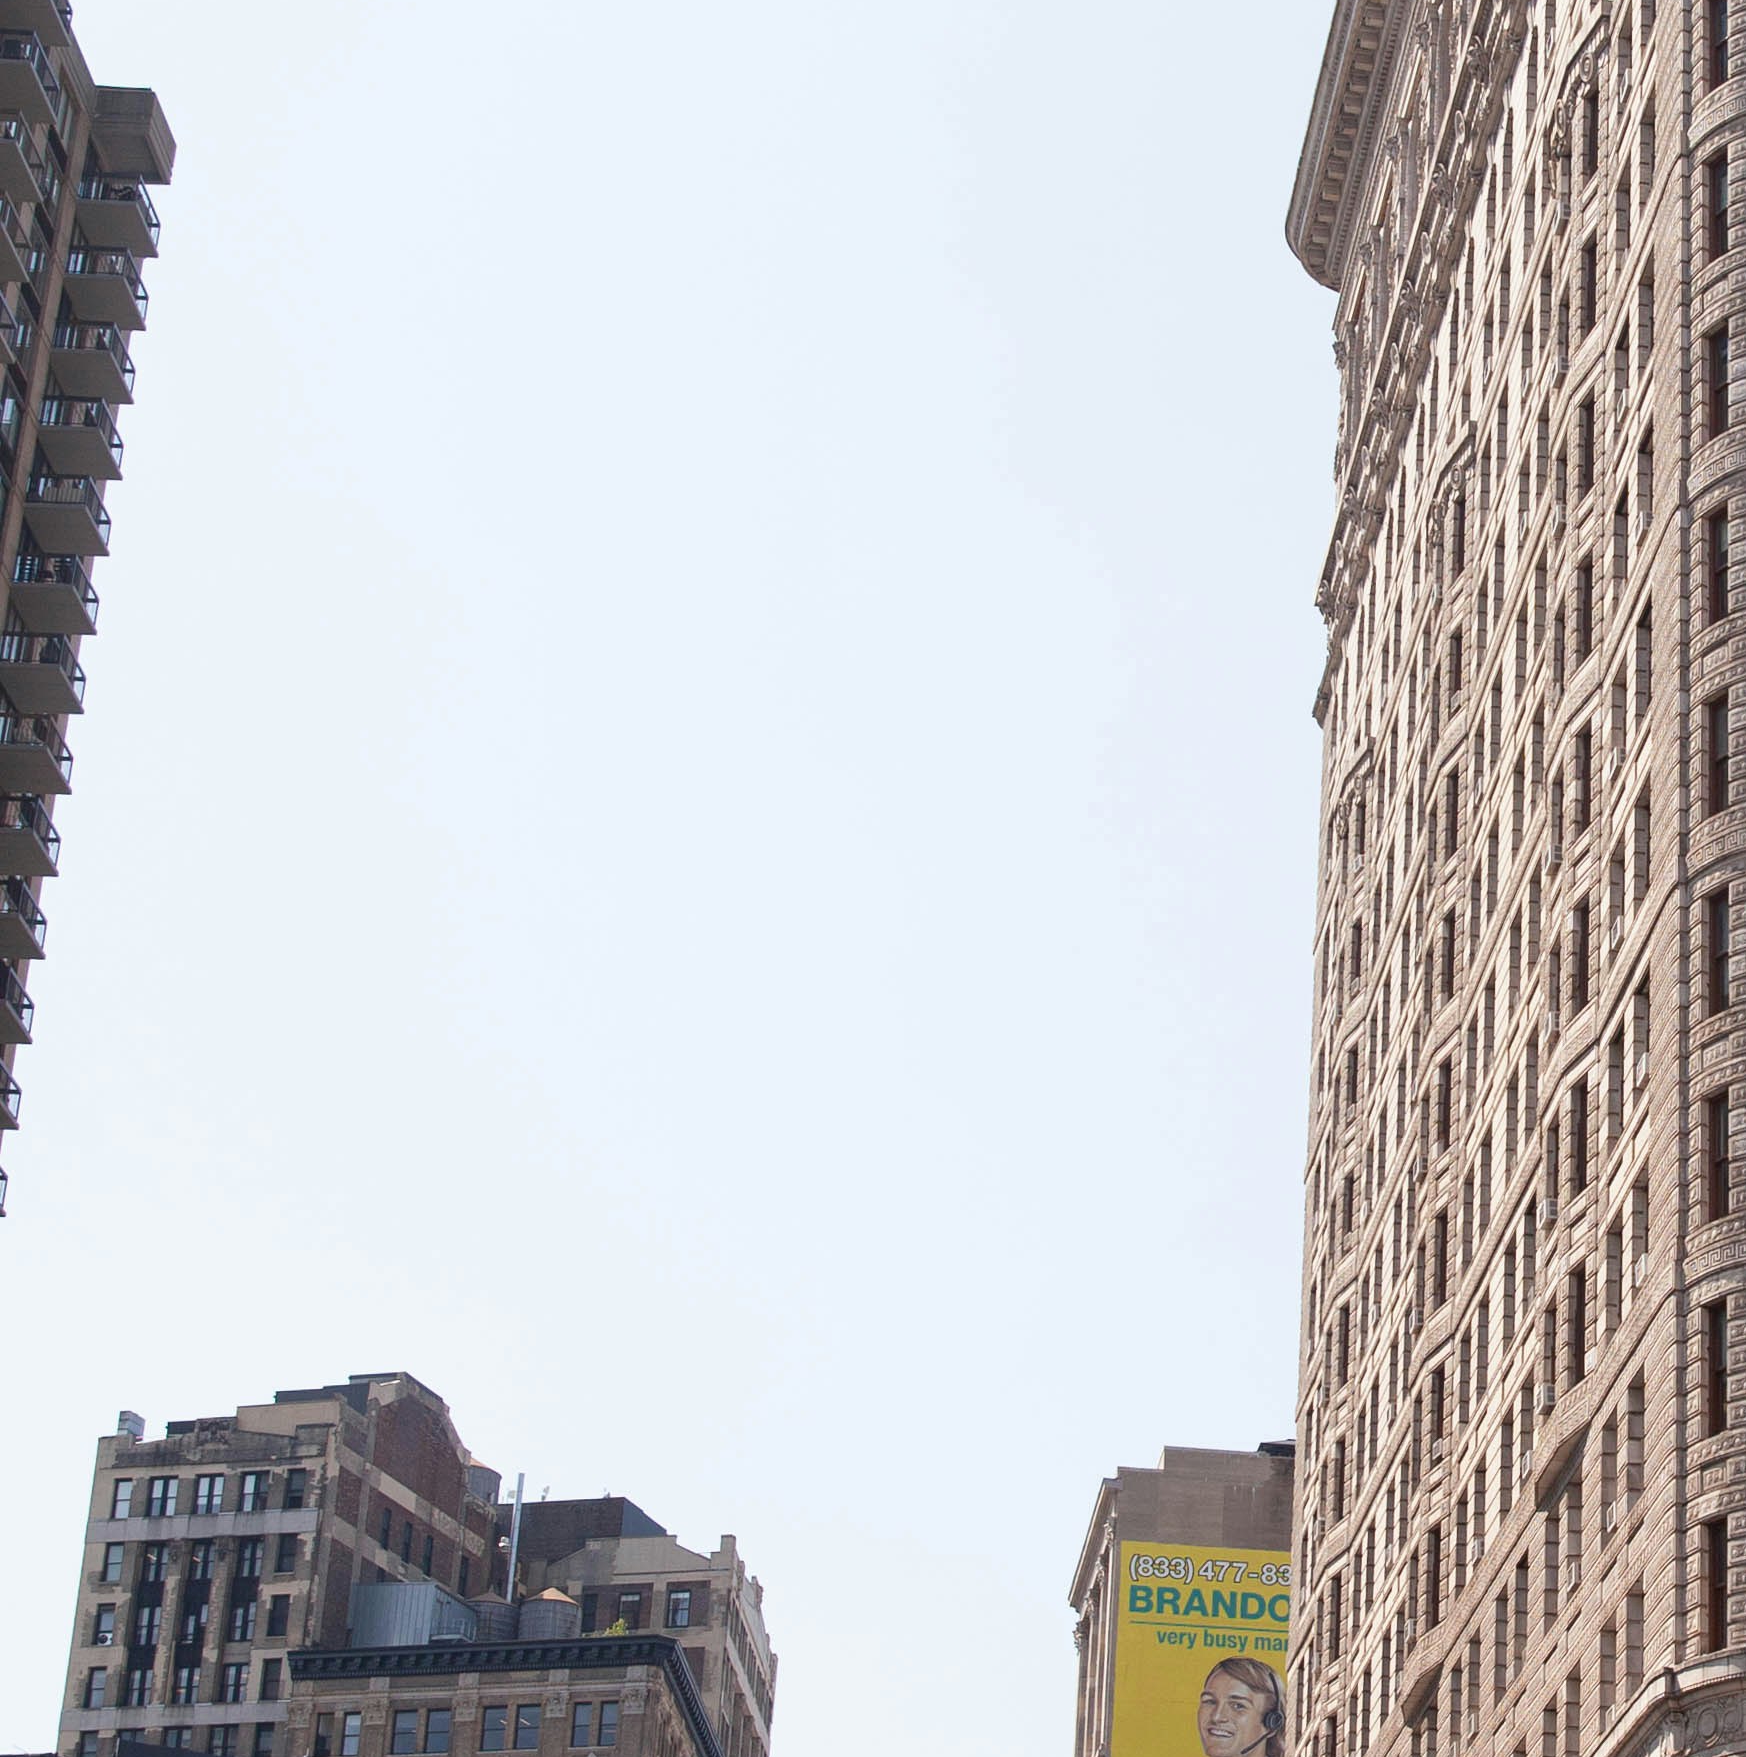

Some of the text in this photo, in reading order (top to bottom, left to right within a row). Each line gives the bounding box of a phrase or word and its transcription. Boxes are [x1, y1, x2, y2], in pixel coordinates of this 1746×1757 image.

[1129, 1554, 1194, 1584] (833)
[1157, 1631, 1197, 1649] very
[1203, 1628, 1248, 1652] busy
